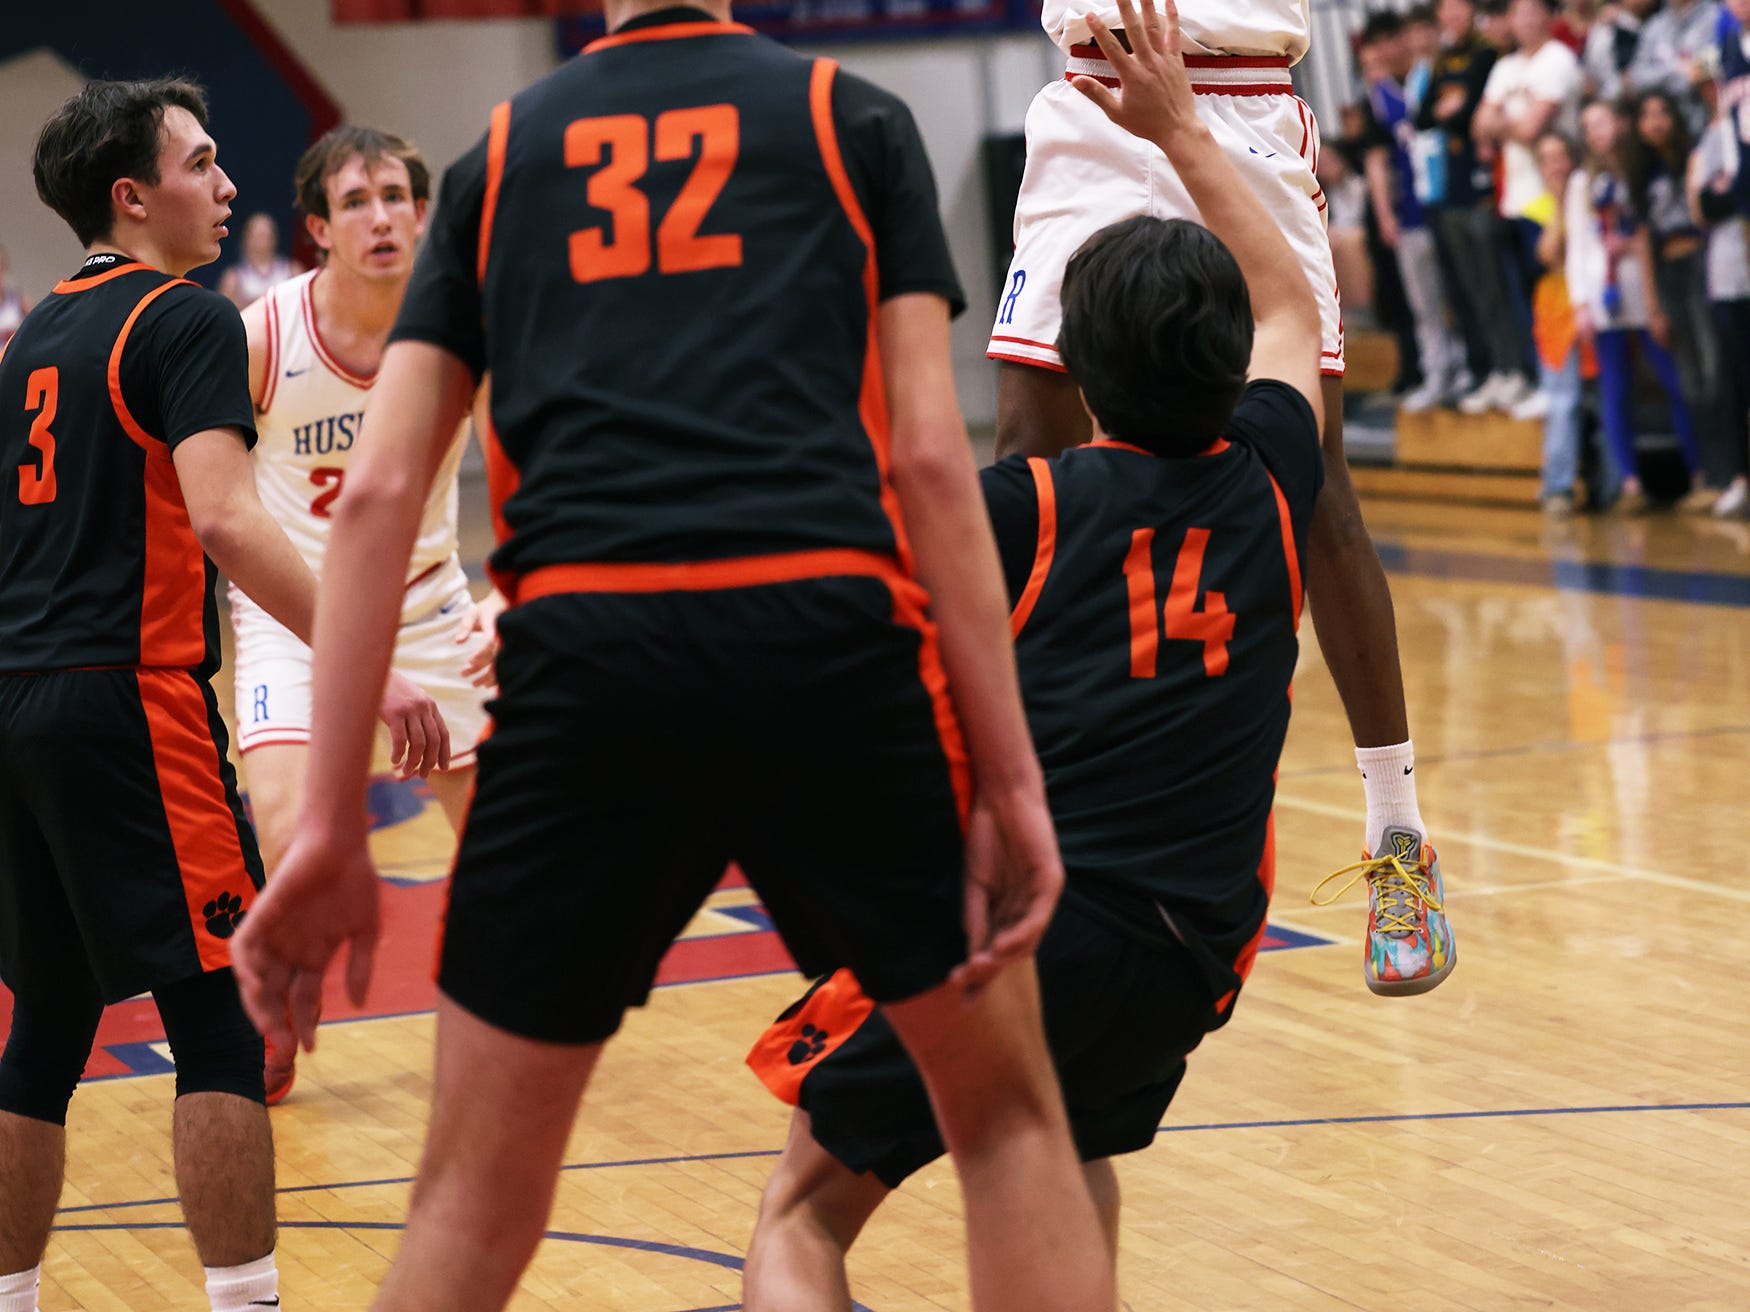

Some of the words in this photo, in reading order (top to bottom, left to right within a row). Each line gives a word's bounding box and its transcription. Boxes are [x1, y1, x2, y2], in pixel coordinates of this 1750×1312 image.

[563, 103, 743, 285] 32
[999, 269, 1027, 325] R
[18, 365, 59, 506] 3
[1122, 527, 1237, 679] 14
[253, 684, 270, 724] R
